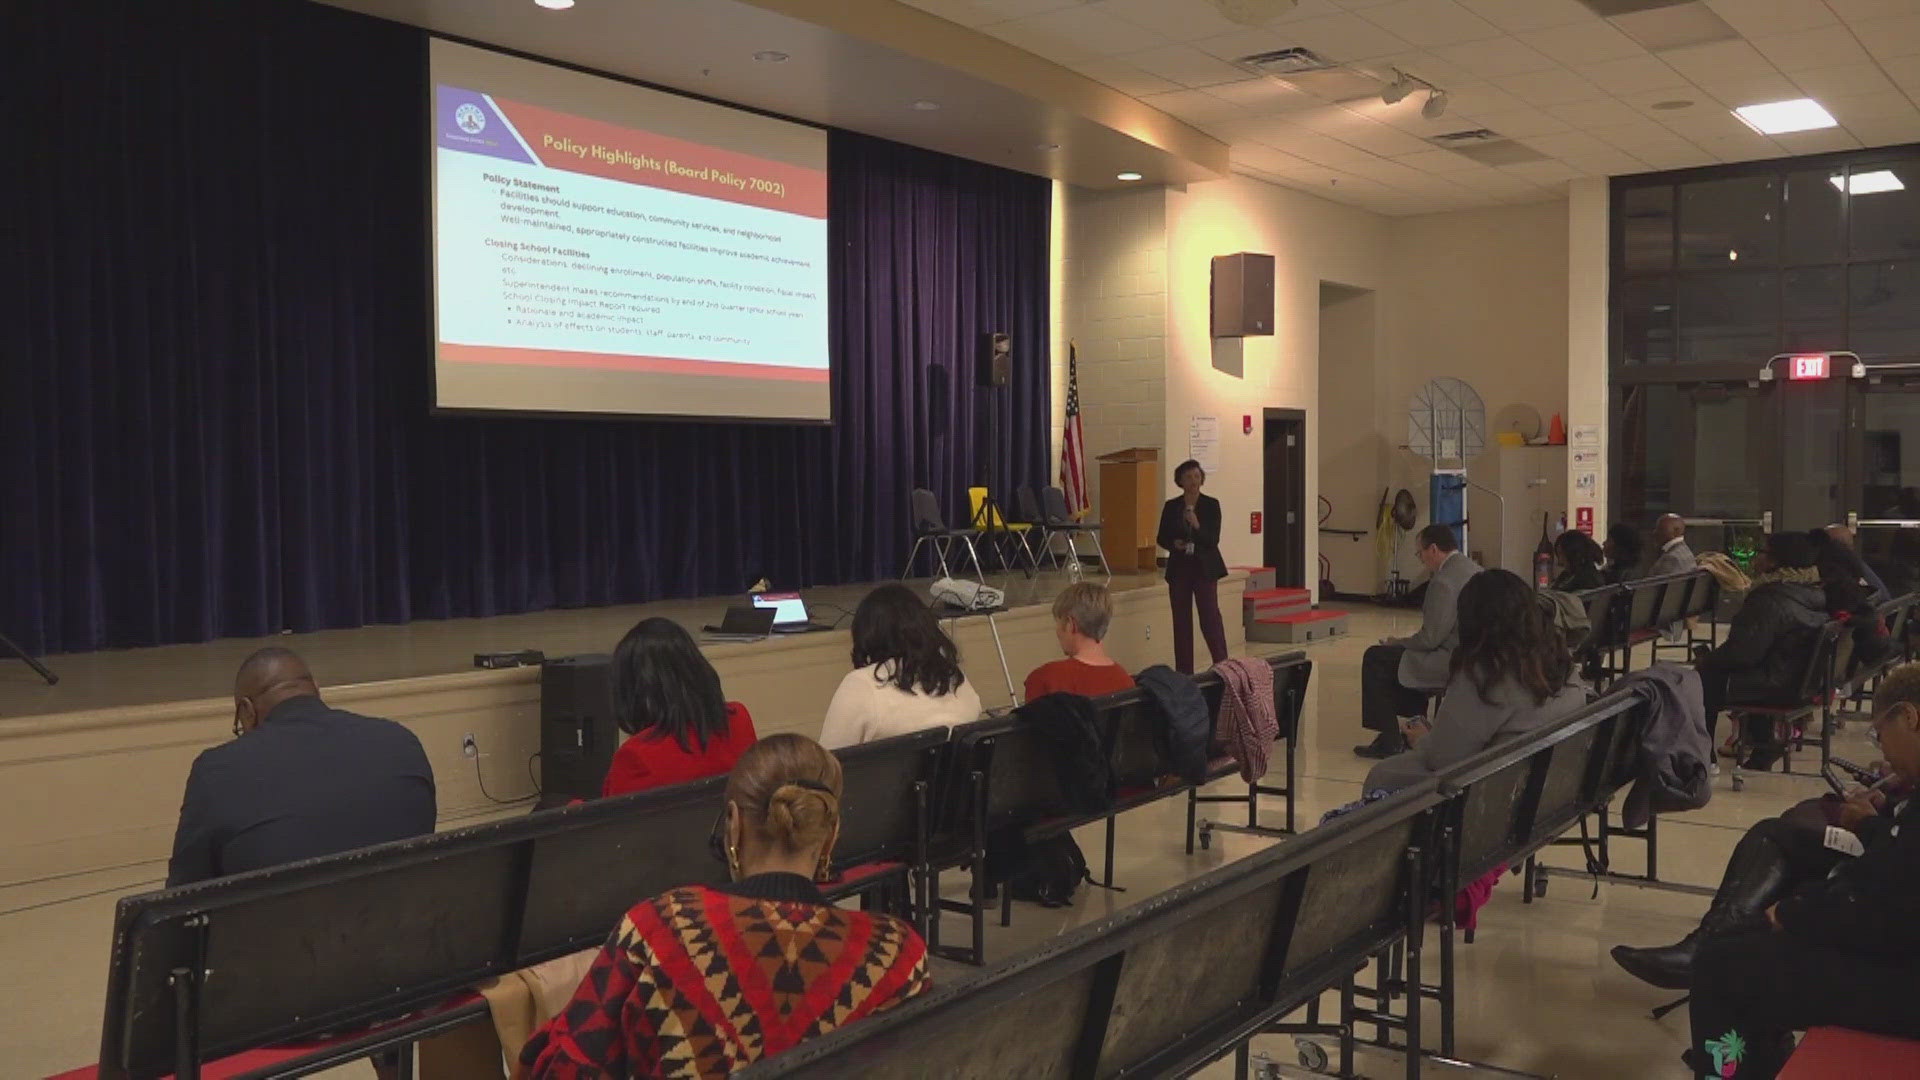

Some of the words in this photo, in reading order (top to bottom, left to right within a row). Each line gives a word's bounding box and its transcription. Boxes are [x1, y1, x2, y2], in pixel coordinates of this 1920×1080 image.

[543, 134, 588, 159] Policy
[591, 145, 662, 171] Highlights
[664, 159, 709, 181] (Board
[711, 169, 747, 190] Policy
[749, 177, 786, 198] 7002)
[483, 173, 512, 186] Policy
[513, 178, 560, 194] Statement
[500, 188, 540, 203] Facilities
[541, 196, 571, 208] should
[572, 202, 605, 214] support
[606, 207, 647, 222] education,
[648, 214, 690, 229] community
[723, 227, 736, 236] and
[500, 214, 574, 234] Well-maintained,
[632, 235, 678, 248] constructed
[678, 240, 709, 252] facilities
[485, 237, 518, 252] Closing
[520, 242, 551, 255] School
[552, 247, 591, 259] Facilities
[571, 261, 609, 276] declining
[656, 271, 697, 284] population
[719, 281, 743, 292] facility
[502, 278, 570, 293] Superintendent
[572, 286, 599, 297] makes
[600, 289, 670, 304] recommendations
[671, 297, 681, 306] by
[681, 298, 696, 306] end
[502, 290, 533, 301] School
[534, 294, 567, 307] Closing
[600, 301, 627, 311] Report
[516, 318, 552, 330] Analysis
[554, 320, 563, 328] of
[565, 322, 594, 332] effects
[559, 310, 575, 318] and
[1796, 357, 1824, 377] EXIT
